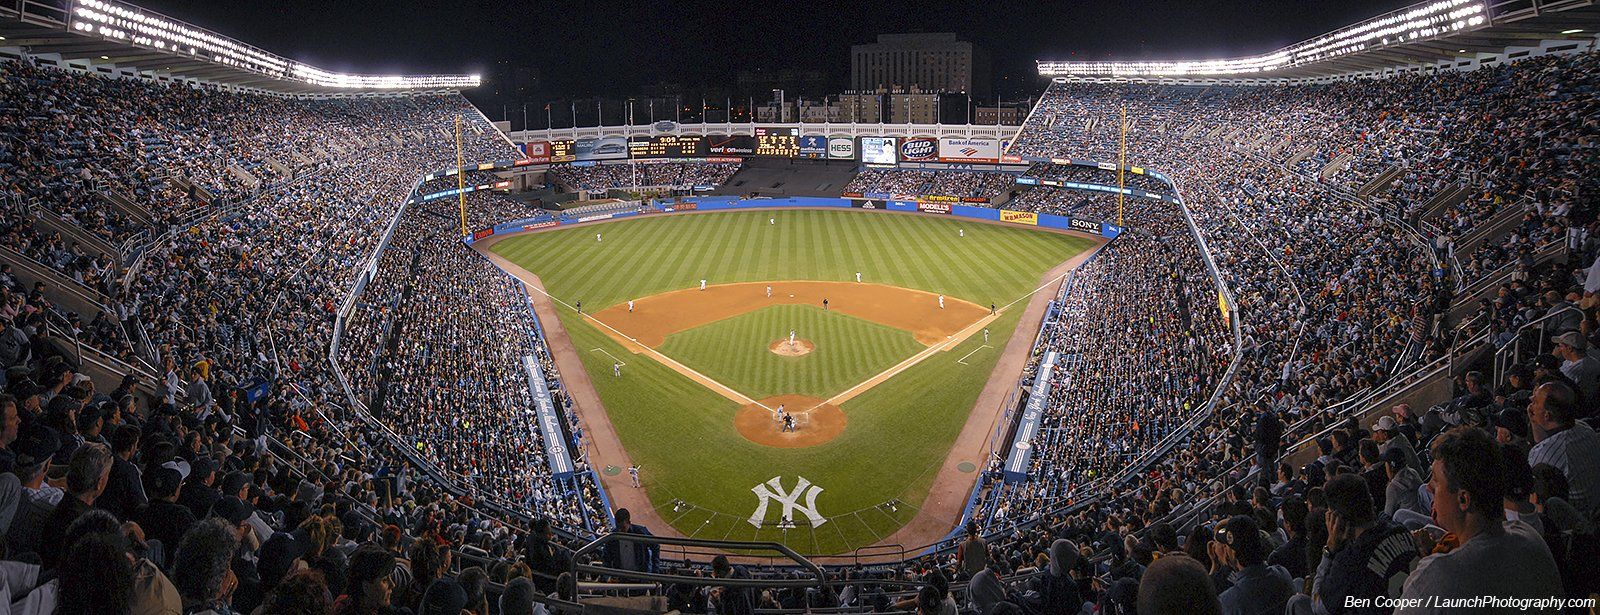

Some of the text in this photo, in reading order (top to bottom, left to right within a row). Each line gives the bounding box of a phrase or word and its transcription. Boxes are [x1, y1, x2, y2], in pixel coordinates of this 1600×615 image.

[831, 144, 852, 152] HESS
[907, 141, 931, 149] BUD
[903, 146, 934, 156] LIGHT
[1071, 219, 1099, 230] SONY
[747, 475, 828, 529] NY
